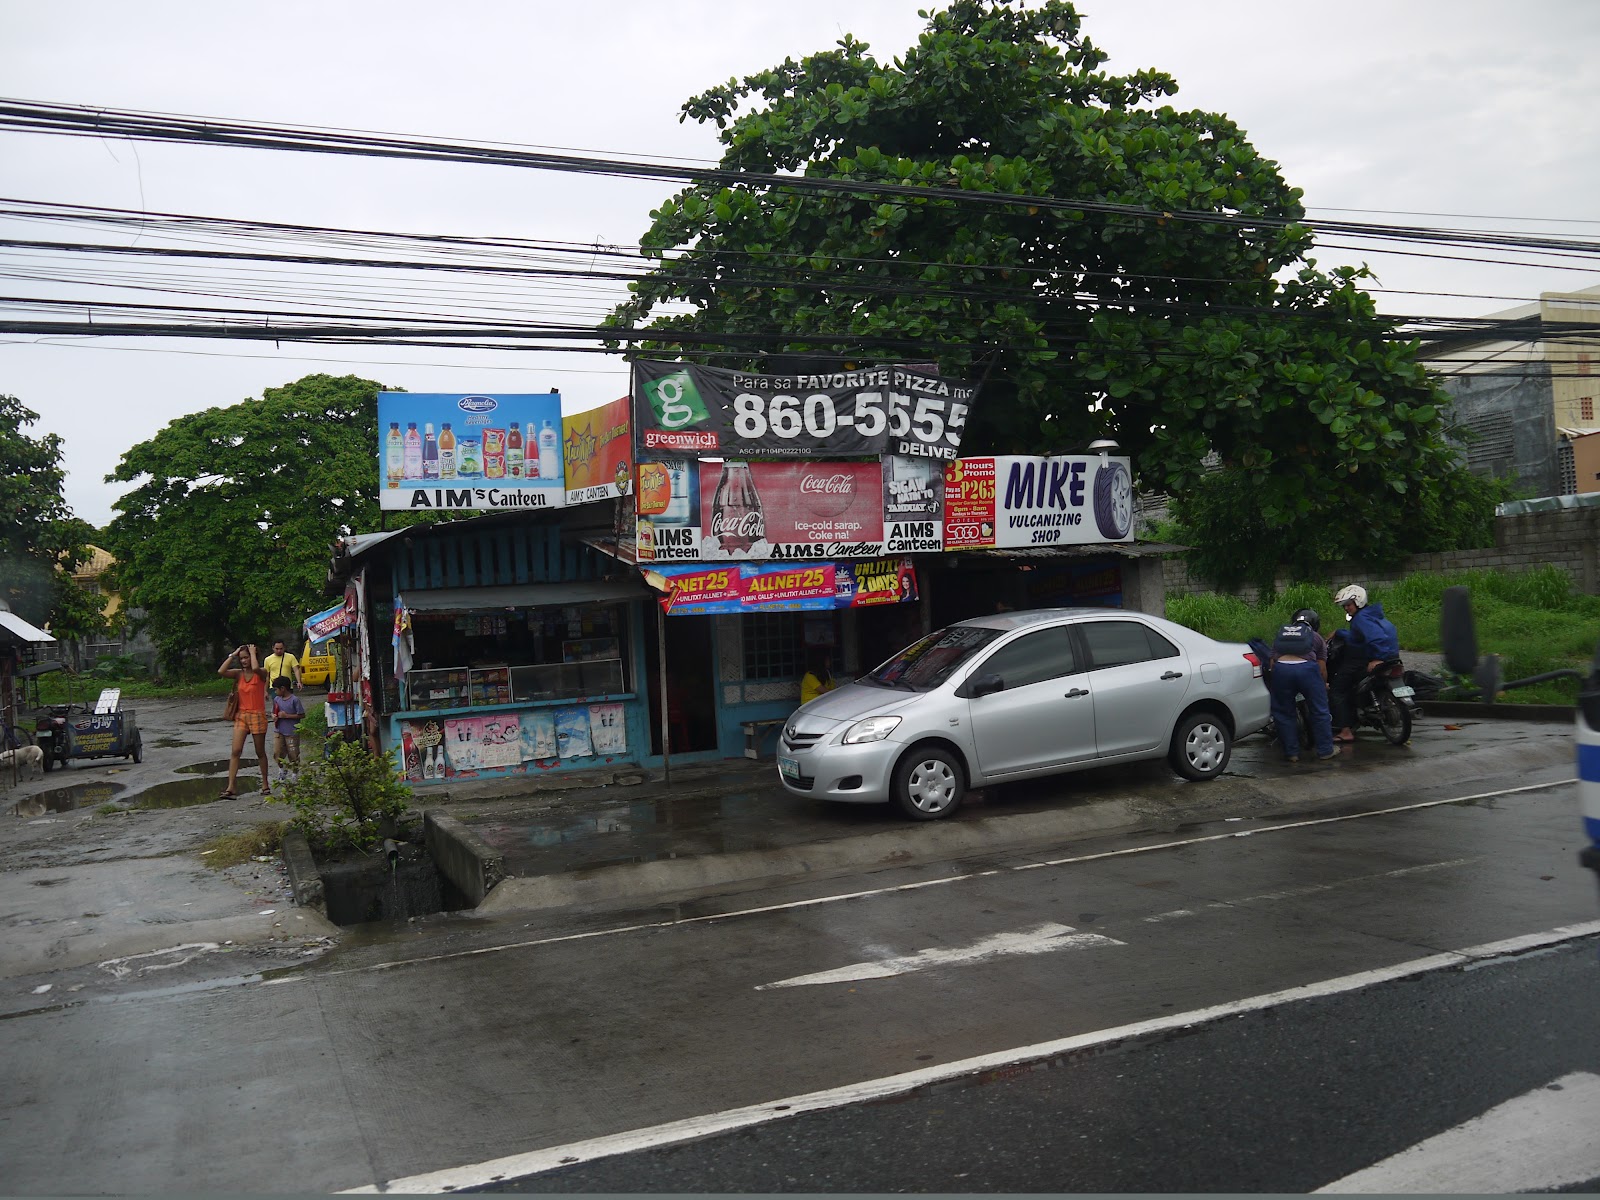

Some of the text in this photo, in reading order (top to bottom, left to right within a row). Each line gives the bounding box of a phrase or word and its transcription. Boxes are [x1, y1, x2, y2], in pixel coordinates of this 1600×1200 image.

[733, 375, 769, 389] Para
[773, 378, 791, 389] sa
[894, 371, 949, 396] PIZZA
[460, 399, 495, 410] Magnolia
[733, 392, 969, 447] 860-5555
[646, 432, 717, 448] greenwich
[946, 459, 964, 483] 3
[965, 462, 994, 470] Hours
[800, 474, 854, 494] Coca-Cola
[888, 478, 927, 495] SIGAW
[960, 479, 995, 500] P265
[1004, 461, 1087, 511] MIKE
[488, 488, 547, 506] Canteen
[570, 485, 609, 502] AIM'S CANTEEN
[896, 491, 921, 504] NATIN
[887, 503, 927, 513] TANDUAY
[795, 520, 862, 533] Ice-cold sarap.
[1009, 513, 1082, 528] VULCANIZING
[808, 529, 849, 540] Coke na!
[890, 522, 934, 539] AIMS
[946, 522, 980, 540] SOGO
[1031, 529, 1061, 544] SHOP
[769, 541, 883, 558] AIMS Canteen
[854, 559, 899, 576] UNLITXT
[798, 588, 818, 596] ALLNET
[857, 573, 900, 594] 2 DAYS
[702, 591, 723, 599] ALLNET
[309, 657, 329, 665] SCHOOL
[93, 720, 112, 729] Jay
